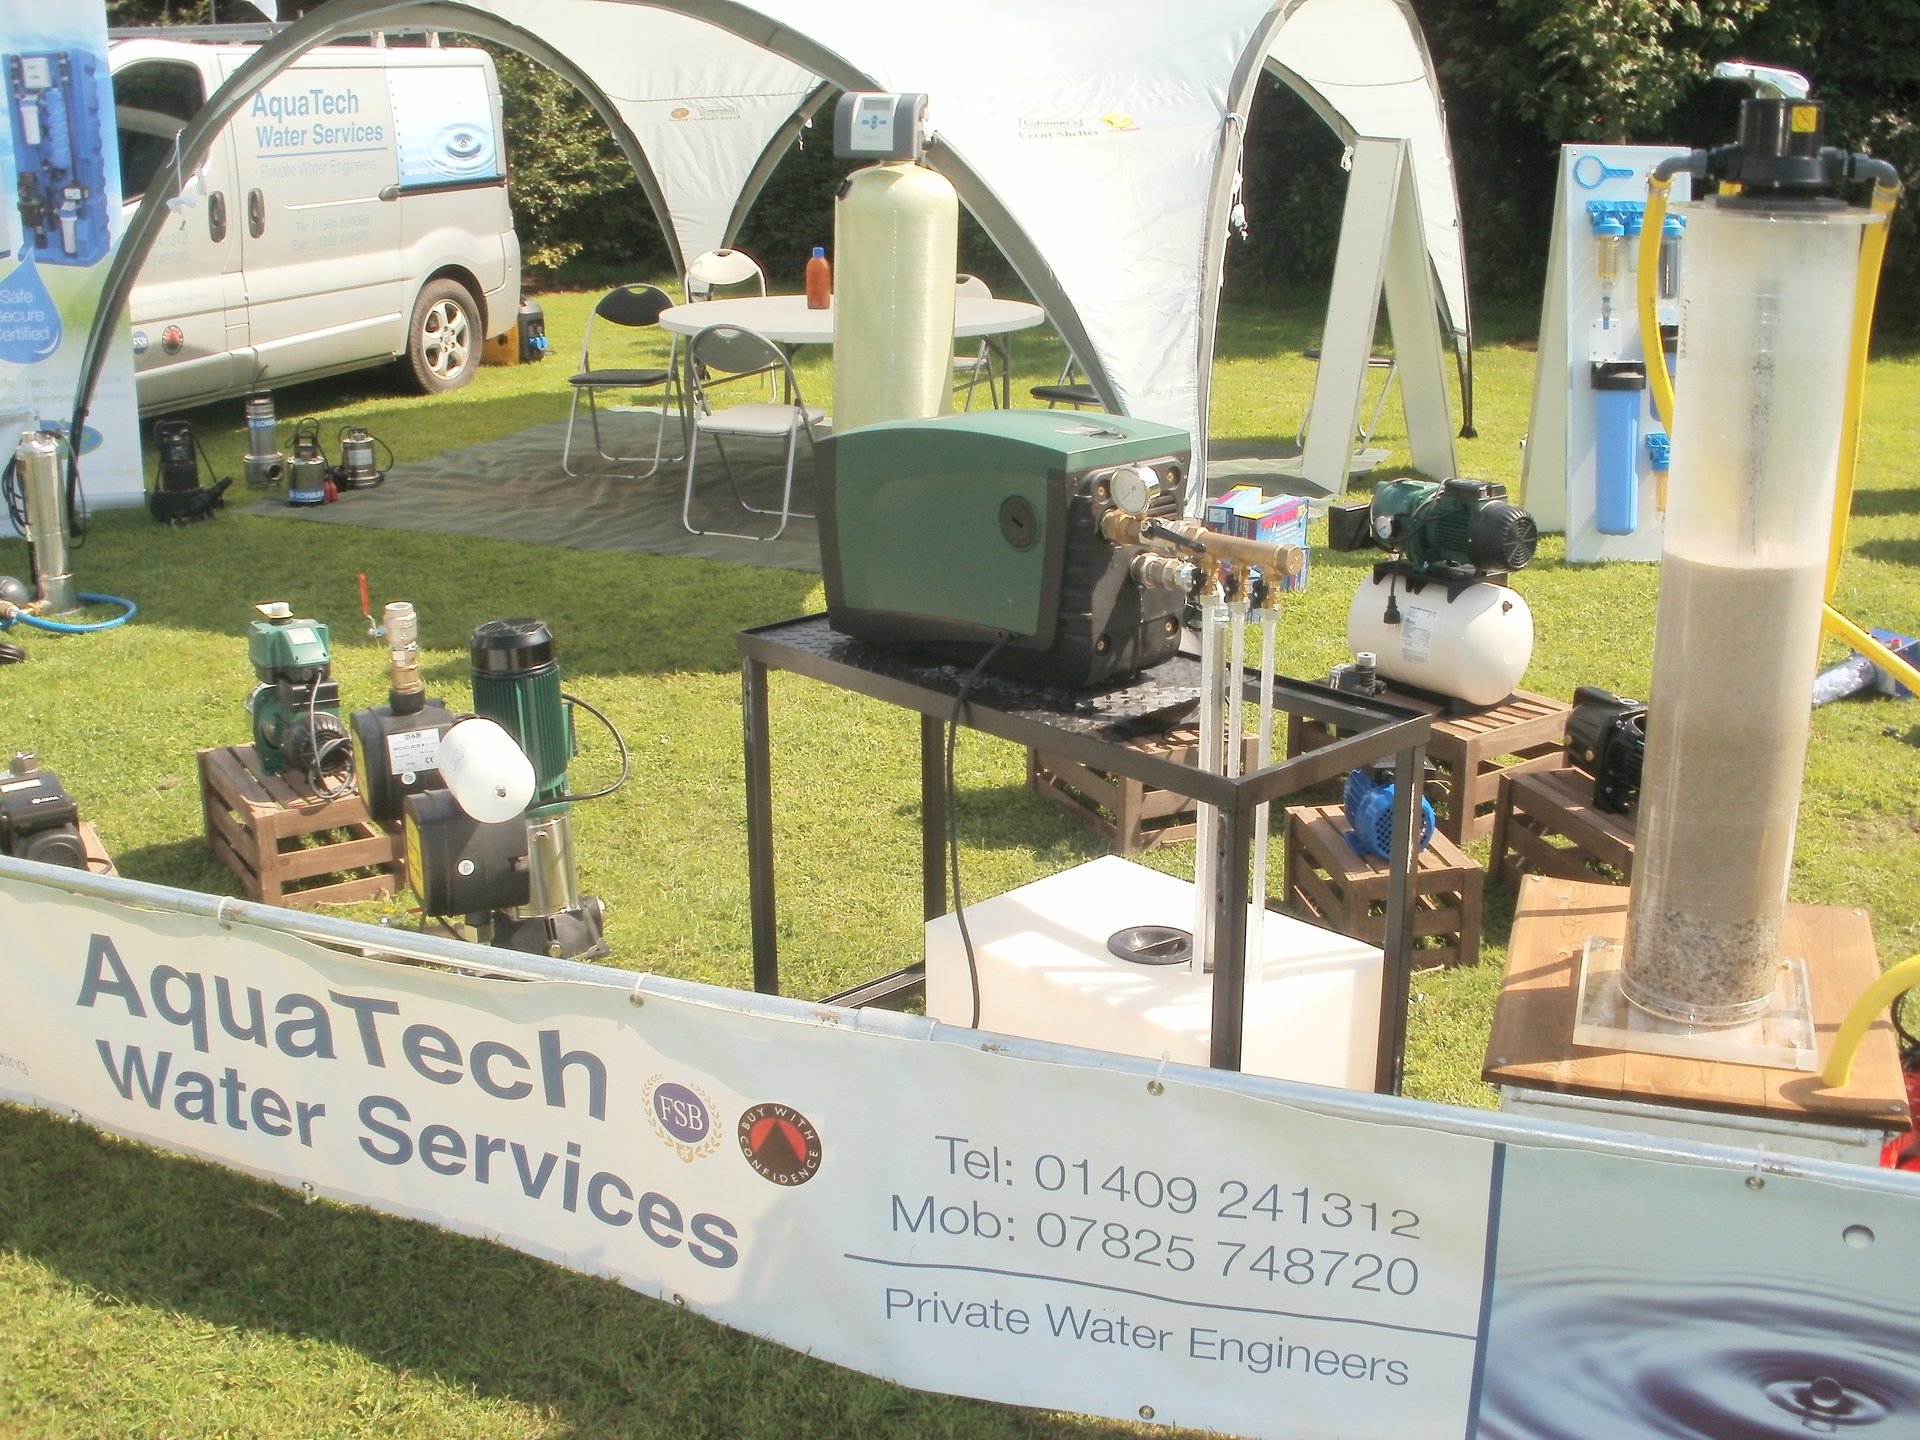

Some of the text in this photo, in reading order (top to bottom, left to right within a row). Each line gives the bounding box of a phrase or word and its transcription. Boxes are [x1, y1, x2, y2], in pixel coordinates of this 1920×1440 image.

[251, 88, 359, 124] AquaTech
[256, 121, 384, 148] Water Services
[261, 159, 377, 179] Private Water Engineers
[0, 289, 33, 304] Safe
[0, 309, 45, 323] ecure
[133, 337, 148, 350] FSB
[76, 933, 608, 1122] AquaTech
[658, 1094, 704, 1131] FSB
[741, 1106, 815, 1140] BUY WITH
[95, 1038, 740, 1270] Water Services
[739, 1135, 819, 1184] CONFIDENCE
[935, 1135, 1421, 1240] Tel: 01409 241312
[891, 1195, 1419, 1296] Mob: 07825 748720
[885, 1288, 1410, 1387] Private Water Engineers
